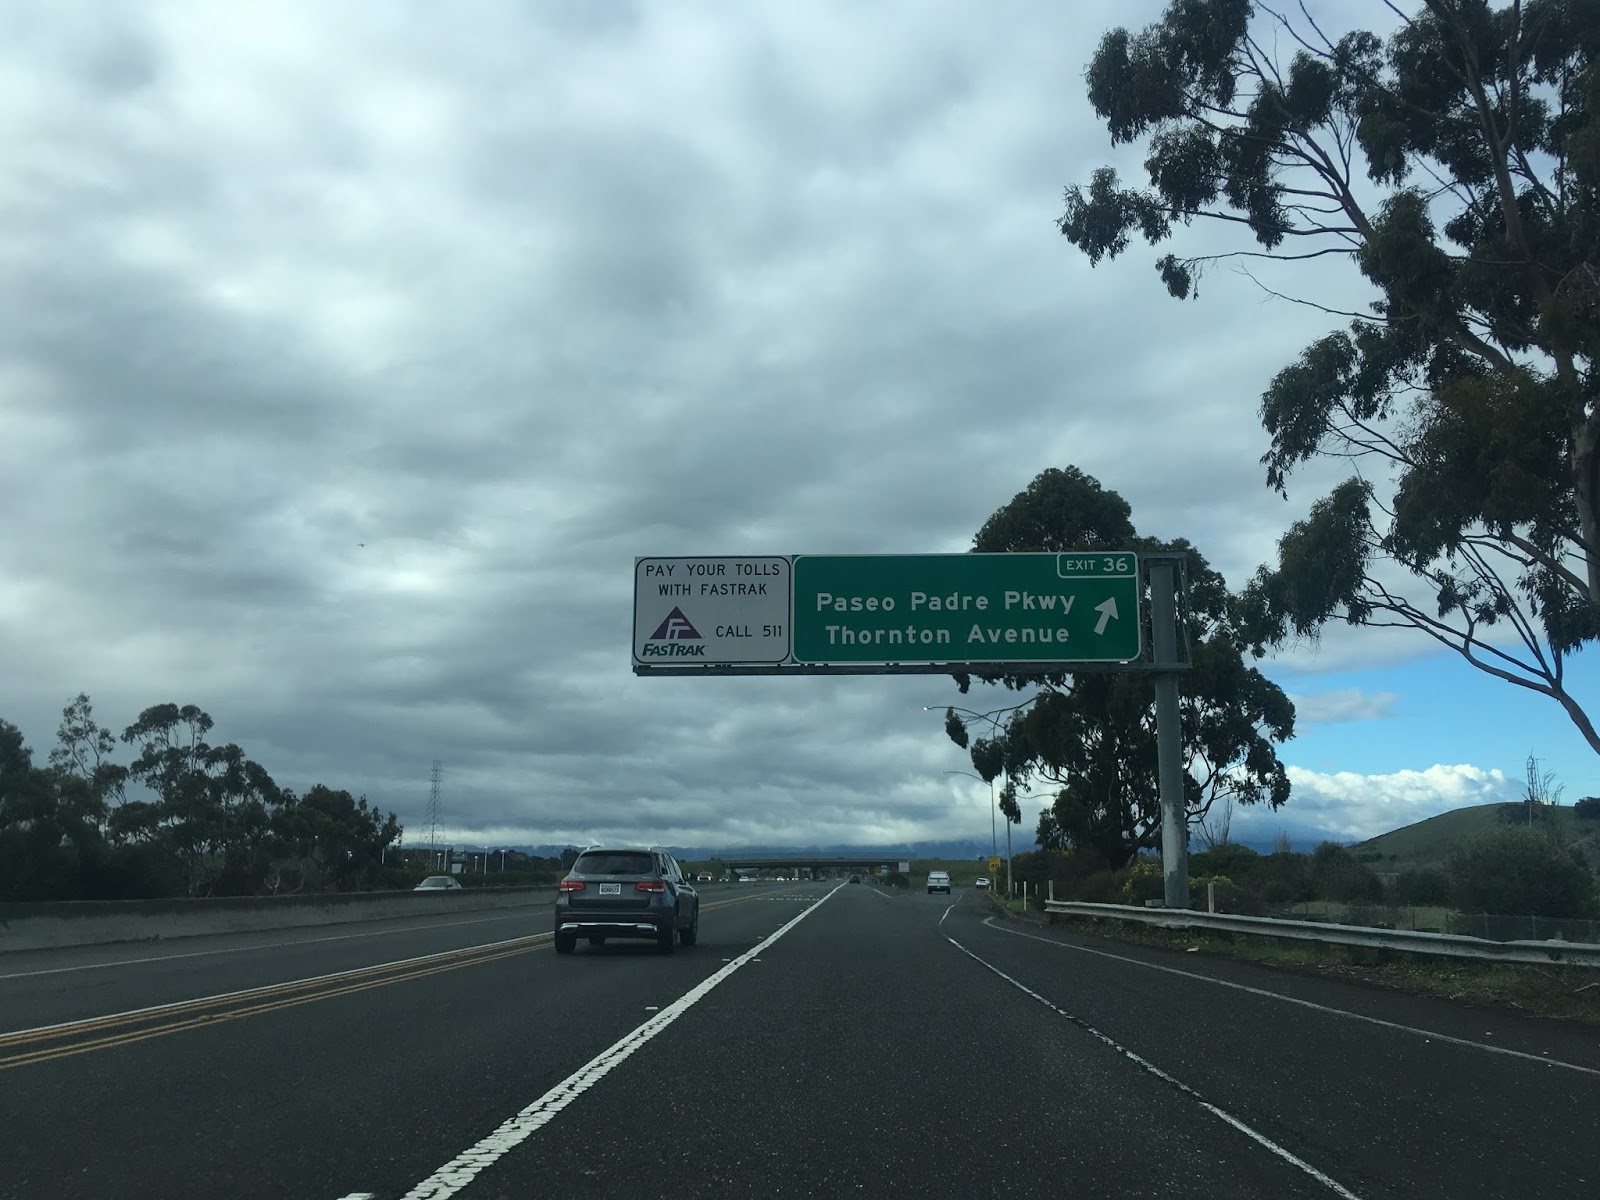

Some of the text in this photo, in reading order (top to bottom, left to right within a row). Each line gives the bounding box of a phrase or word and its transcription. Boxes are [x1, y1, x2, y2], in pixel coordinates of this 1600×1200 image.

[645, 563, 780, 577] PAY YOUR TOLLS
[1066, 557, 1128, 572] EXIT 36
[658, 583, 768, 596] WITH FASTRAK
[816, 590, 1076, 615] Paseo Padre Pkwy
[715, 624, 782, 638] CALL 511
[825, 624, 1070, 645] Thornton Avenue
